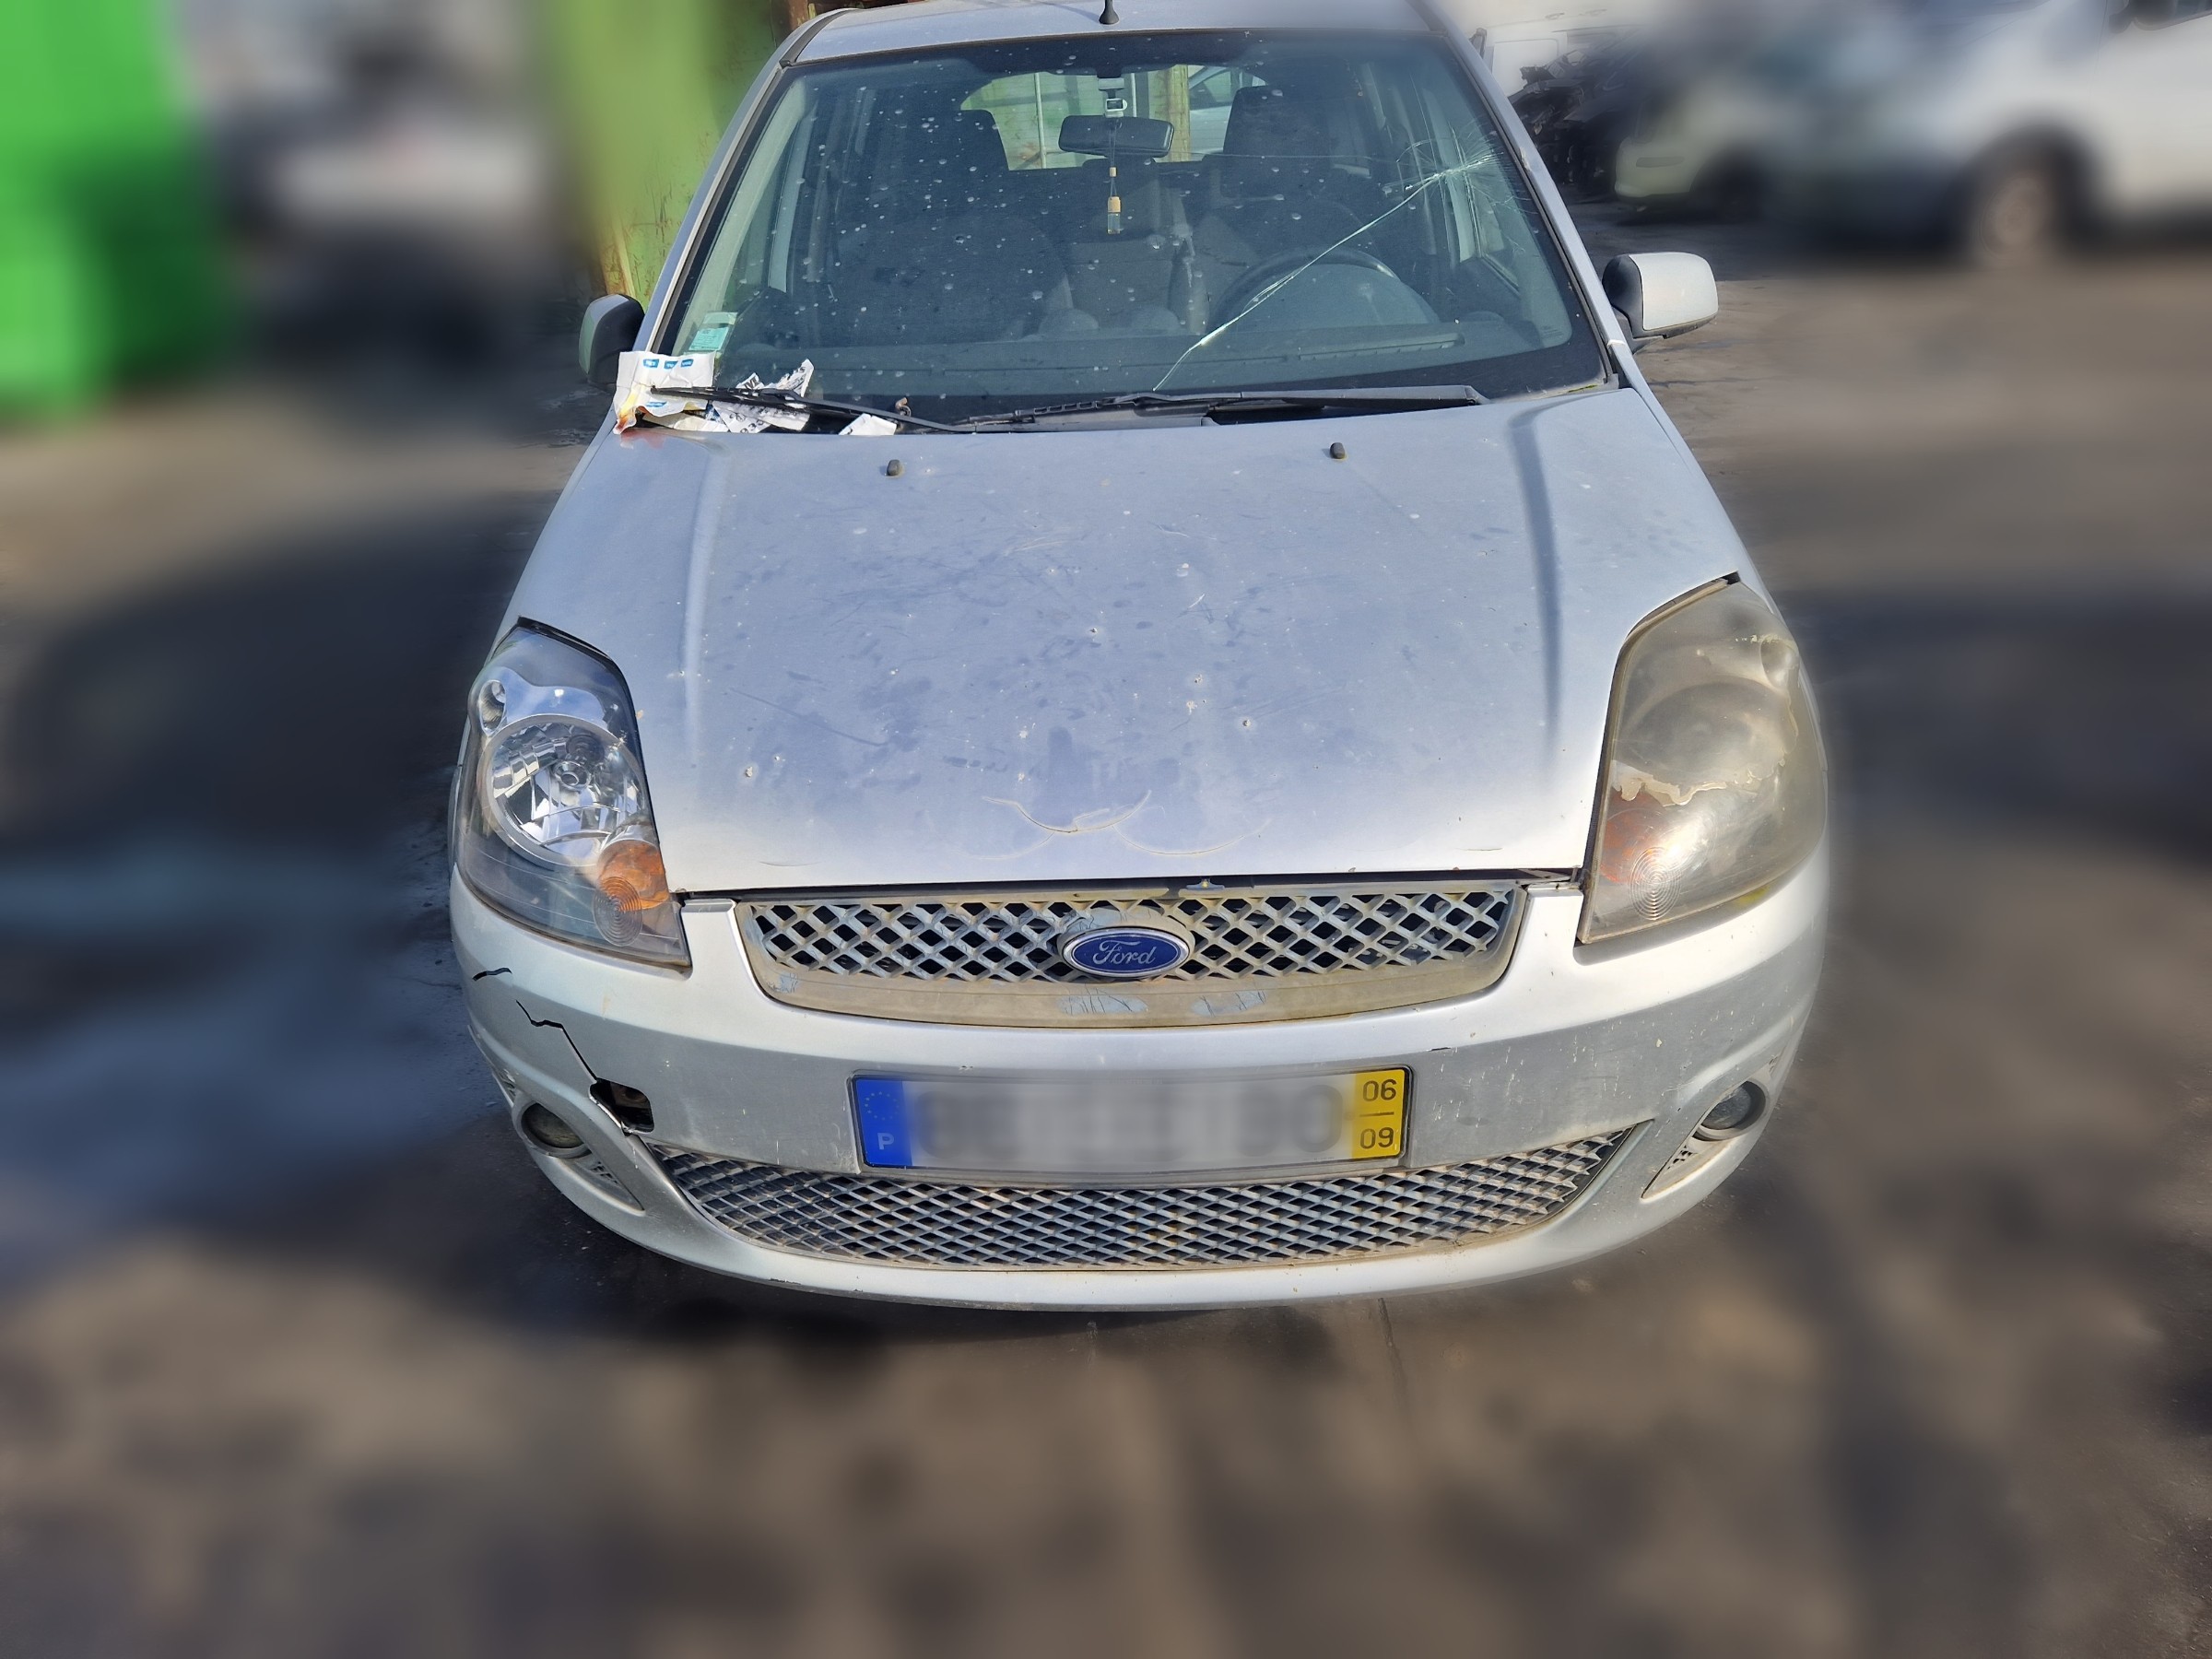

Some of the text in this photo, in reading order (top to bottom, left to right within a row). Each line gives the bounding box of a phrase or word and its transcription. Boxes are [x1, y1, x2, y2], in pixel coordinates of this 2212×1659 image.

[1092, 940, 1157, 964] Ford
[1362, 1079, 1396, 1101] 06
[877, 1133, 894, 1149] P
[1360, 1127, 1394, 1148] 09
